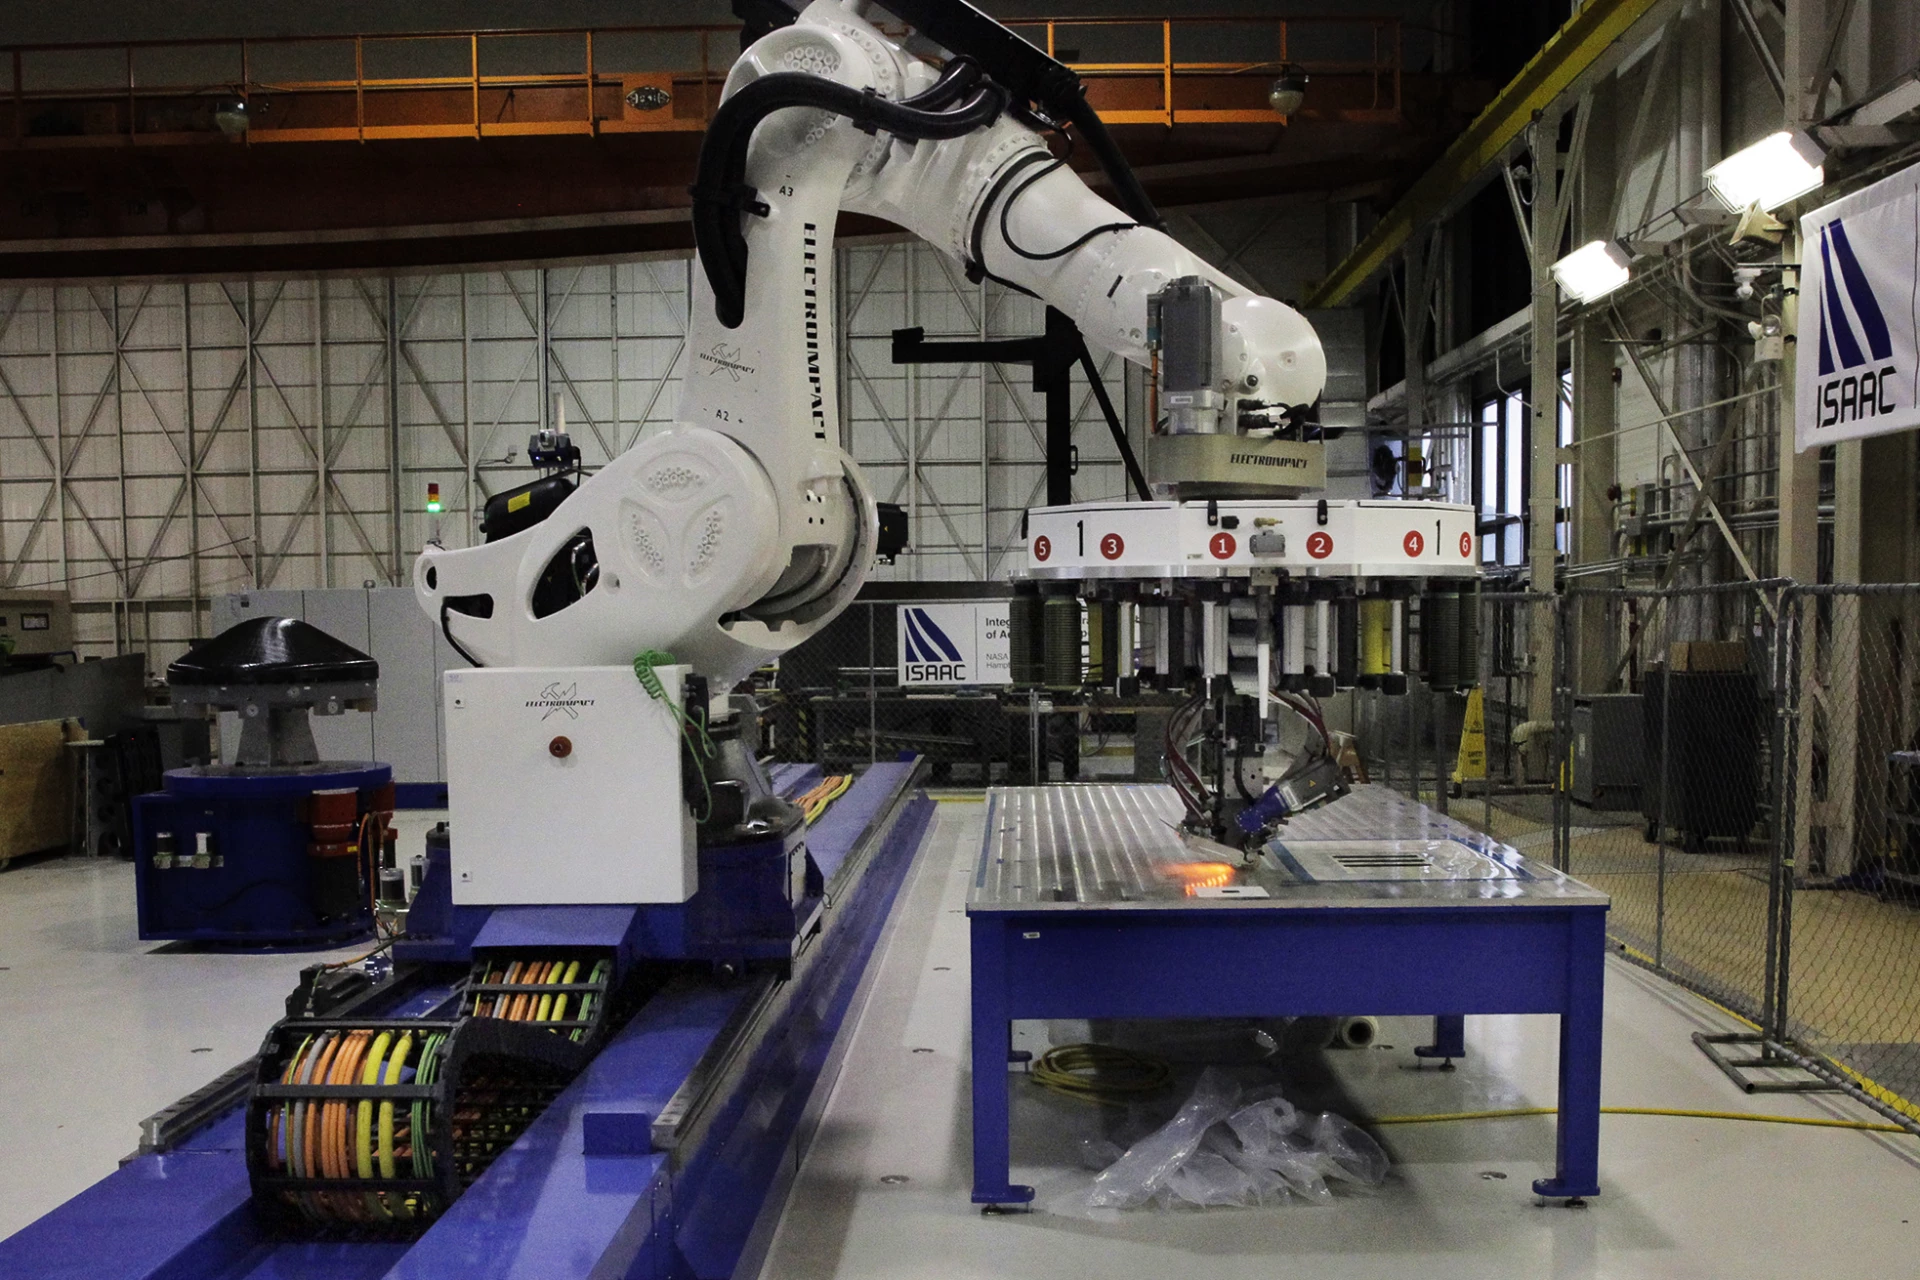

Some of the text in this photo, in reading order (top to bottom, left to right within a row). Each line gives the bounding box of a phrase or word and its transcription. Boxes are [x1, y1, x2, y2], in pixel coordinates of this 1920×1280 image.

[779, 185, 794, 197] A3
[804, 222, 827, 444] ELECTROIMPACT
[1816, 365, 1897, 429] ISAAC
[715, 409, 729, 422] A2
[1230, 453, 1309, 470] ELECTROIMPACT
[1039, 540, 1047, 556] 5
[1107, 539, 1118, 554] 3
[1218, 538, 1228, 554] 1
[1314, 537, 1326, 553] 2
[1408, 536, 1419, 551] 4
[1462, 537, 1469, 552] 6
[985, 630, 997, 640] of
[986, 653, 1009, 661] NASA
[905, 664, 967, 682] ISAAC
